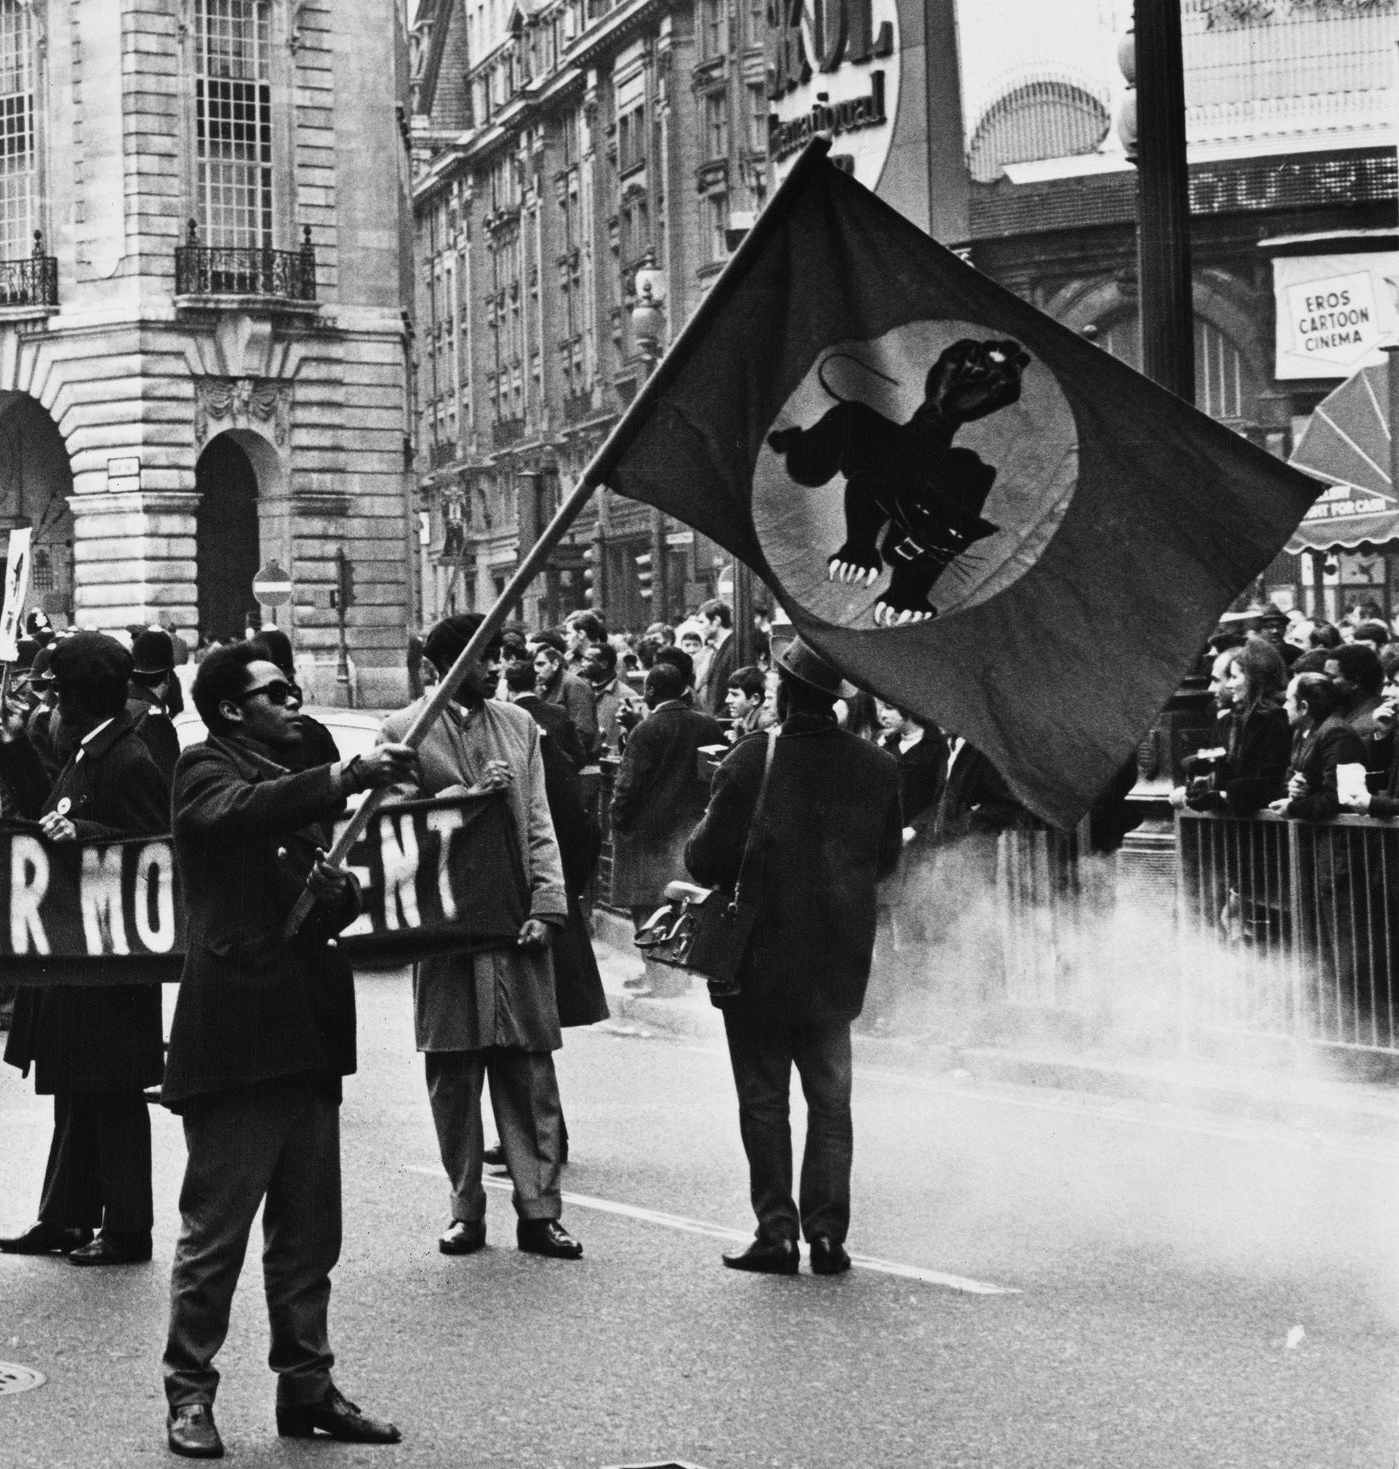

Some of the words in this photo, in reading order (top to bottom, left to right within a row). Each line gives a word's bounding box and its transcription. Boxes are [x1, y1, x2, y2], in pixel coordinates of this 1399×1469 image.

[1305, 290, 1351, 313] EROS
[1299, 307, 1369, 334] CARTOON
[1305, 330, 1363, 351] CINEMA
[1330, 501, 1355, 516] FOR
[80, 808, 465, 956] MOENT
